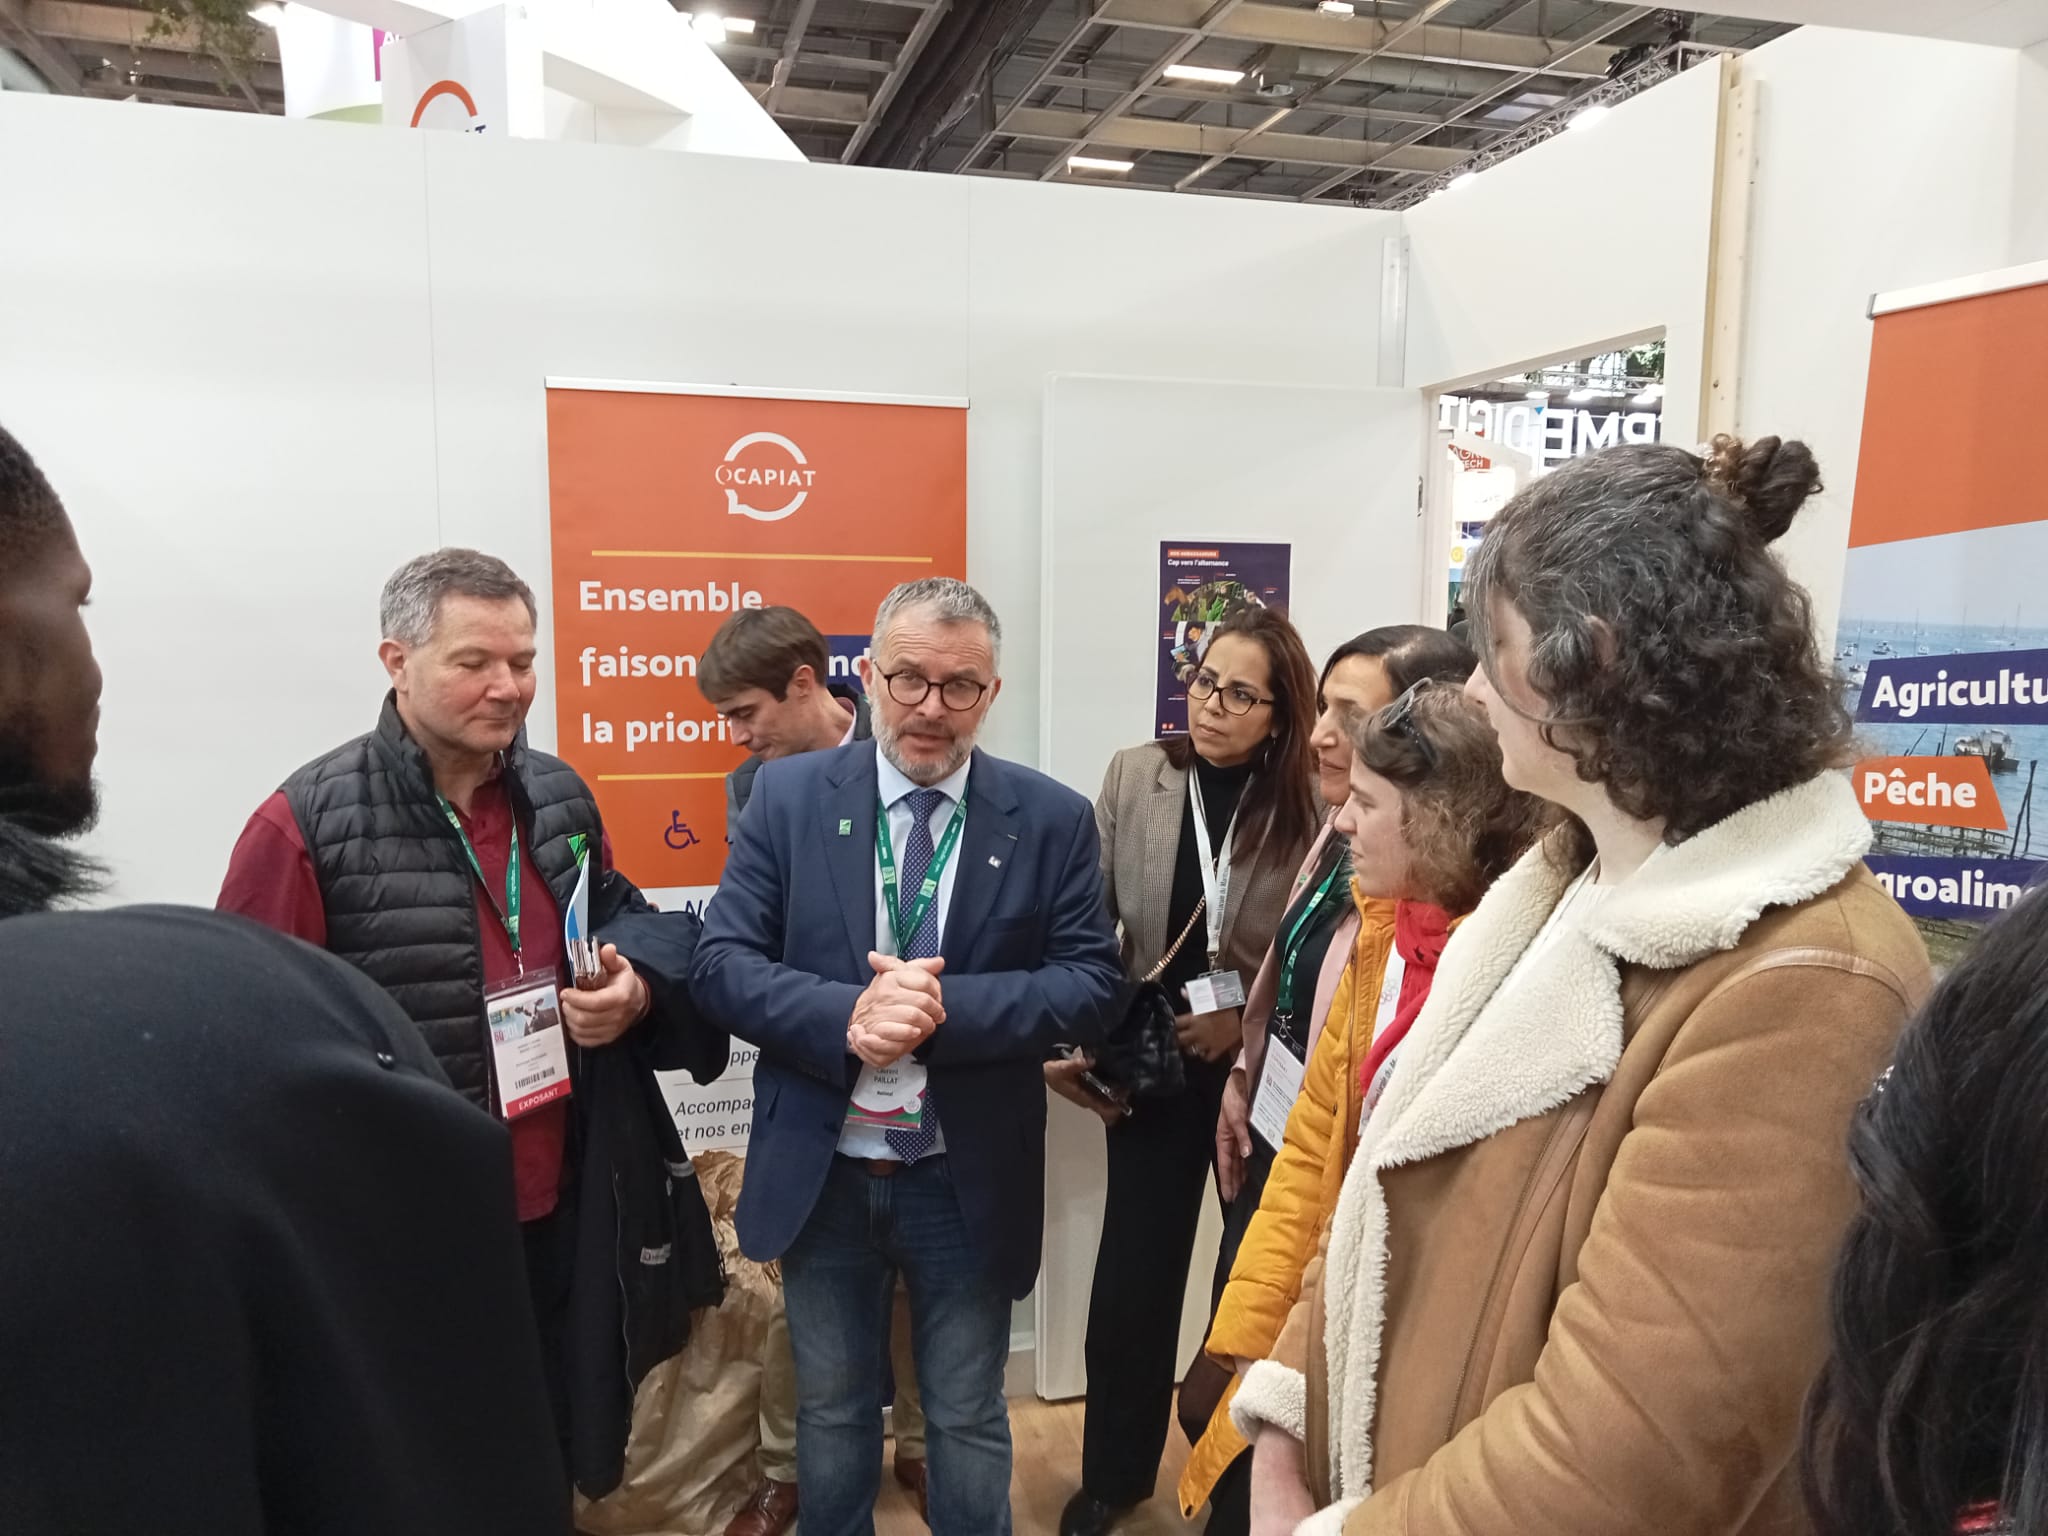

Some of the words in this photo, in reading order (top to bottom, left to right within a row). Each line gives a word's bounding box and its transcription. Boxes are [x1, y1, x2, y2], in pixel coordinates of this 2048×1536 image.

[715, 464, 816, 487] OCAPIAT
[579, 646, 698, 686] faison
[583, 713, 613, 743] la
[626, 712, 733, 752] priori
[1864, 768, 1977, 808] Pêche
[518, 1088, 559, 1110] EXPOSANT
[675, 1098, 753, 1116] Accompa
[695, 1124, 726, 1139] nos
[731, 1122, 751, 1135] en
